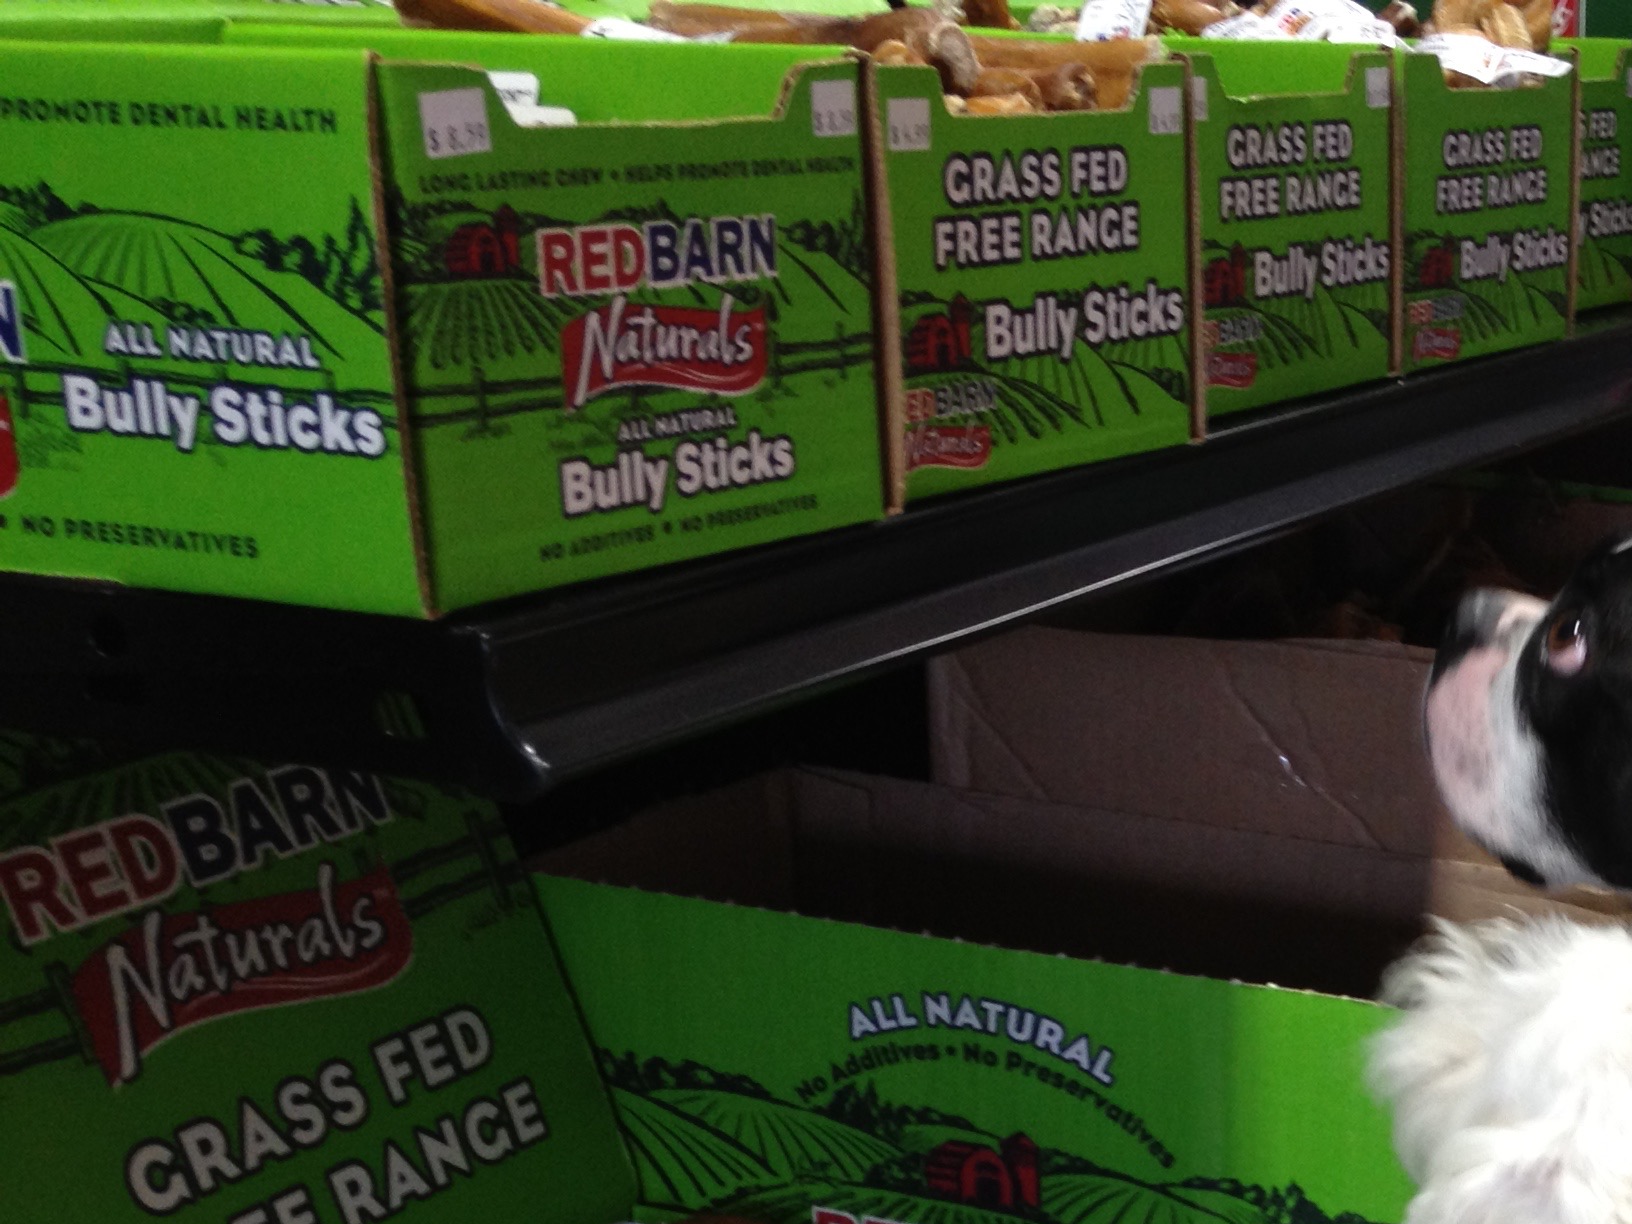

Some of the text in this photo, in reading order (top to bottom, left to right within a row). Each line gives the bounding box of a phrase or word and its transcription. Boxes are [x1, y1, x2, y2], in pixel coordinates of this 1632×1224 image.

[129, 102, 227, 130] DENTAL
[234, 105, 338, 134] HEALTH
[1227, 122, 1307, 169] GRASS
[1312, 119, 1353, 162] FED
[1443, 129, 1506, 169] GRASS
[1510, 124, 1543, 161] FED
[944, 144, 1128, 207] GRASS FED
[1219, 168, 1362, 222] FREE RANGE
[1436, 168, 1547, 214] FREE RANGE
[536, 214, 778, 298] REDBARN
[933, 201, 1140, 270] FREE RANGE
[1254, 235, 1390, 300] Bully Sticks
[1460, 235, 1510, 282] Bully
[1512, 227, 1568, 272] Sticks
[104, 321, 321, 369] ALL NATURAL
[567, 292, 752, 413] Naturals
[984, 279, 1185, 363] Bully Sticks
[62, 373, 388, 458] Bully Sticks
[618, 407, 737, 442] ALL NATURAL
[560, 429, 795, 517] Bully Sticks
[21, 515, 259, 558] NO PRESERVATIVES
[0, 765, 393, 947] REDBARN
[105, 863, 388, 1080] Naturals
[849, 991, 1115, 1087] ALL NATURAL
[124, 1005, 493, 1216] GRASS FED
[795, 1042, 1175, 1169] No Additives No Preservatives
